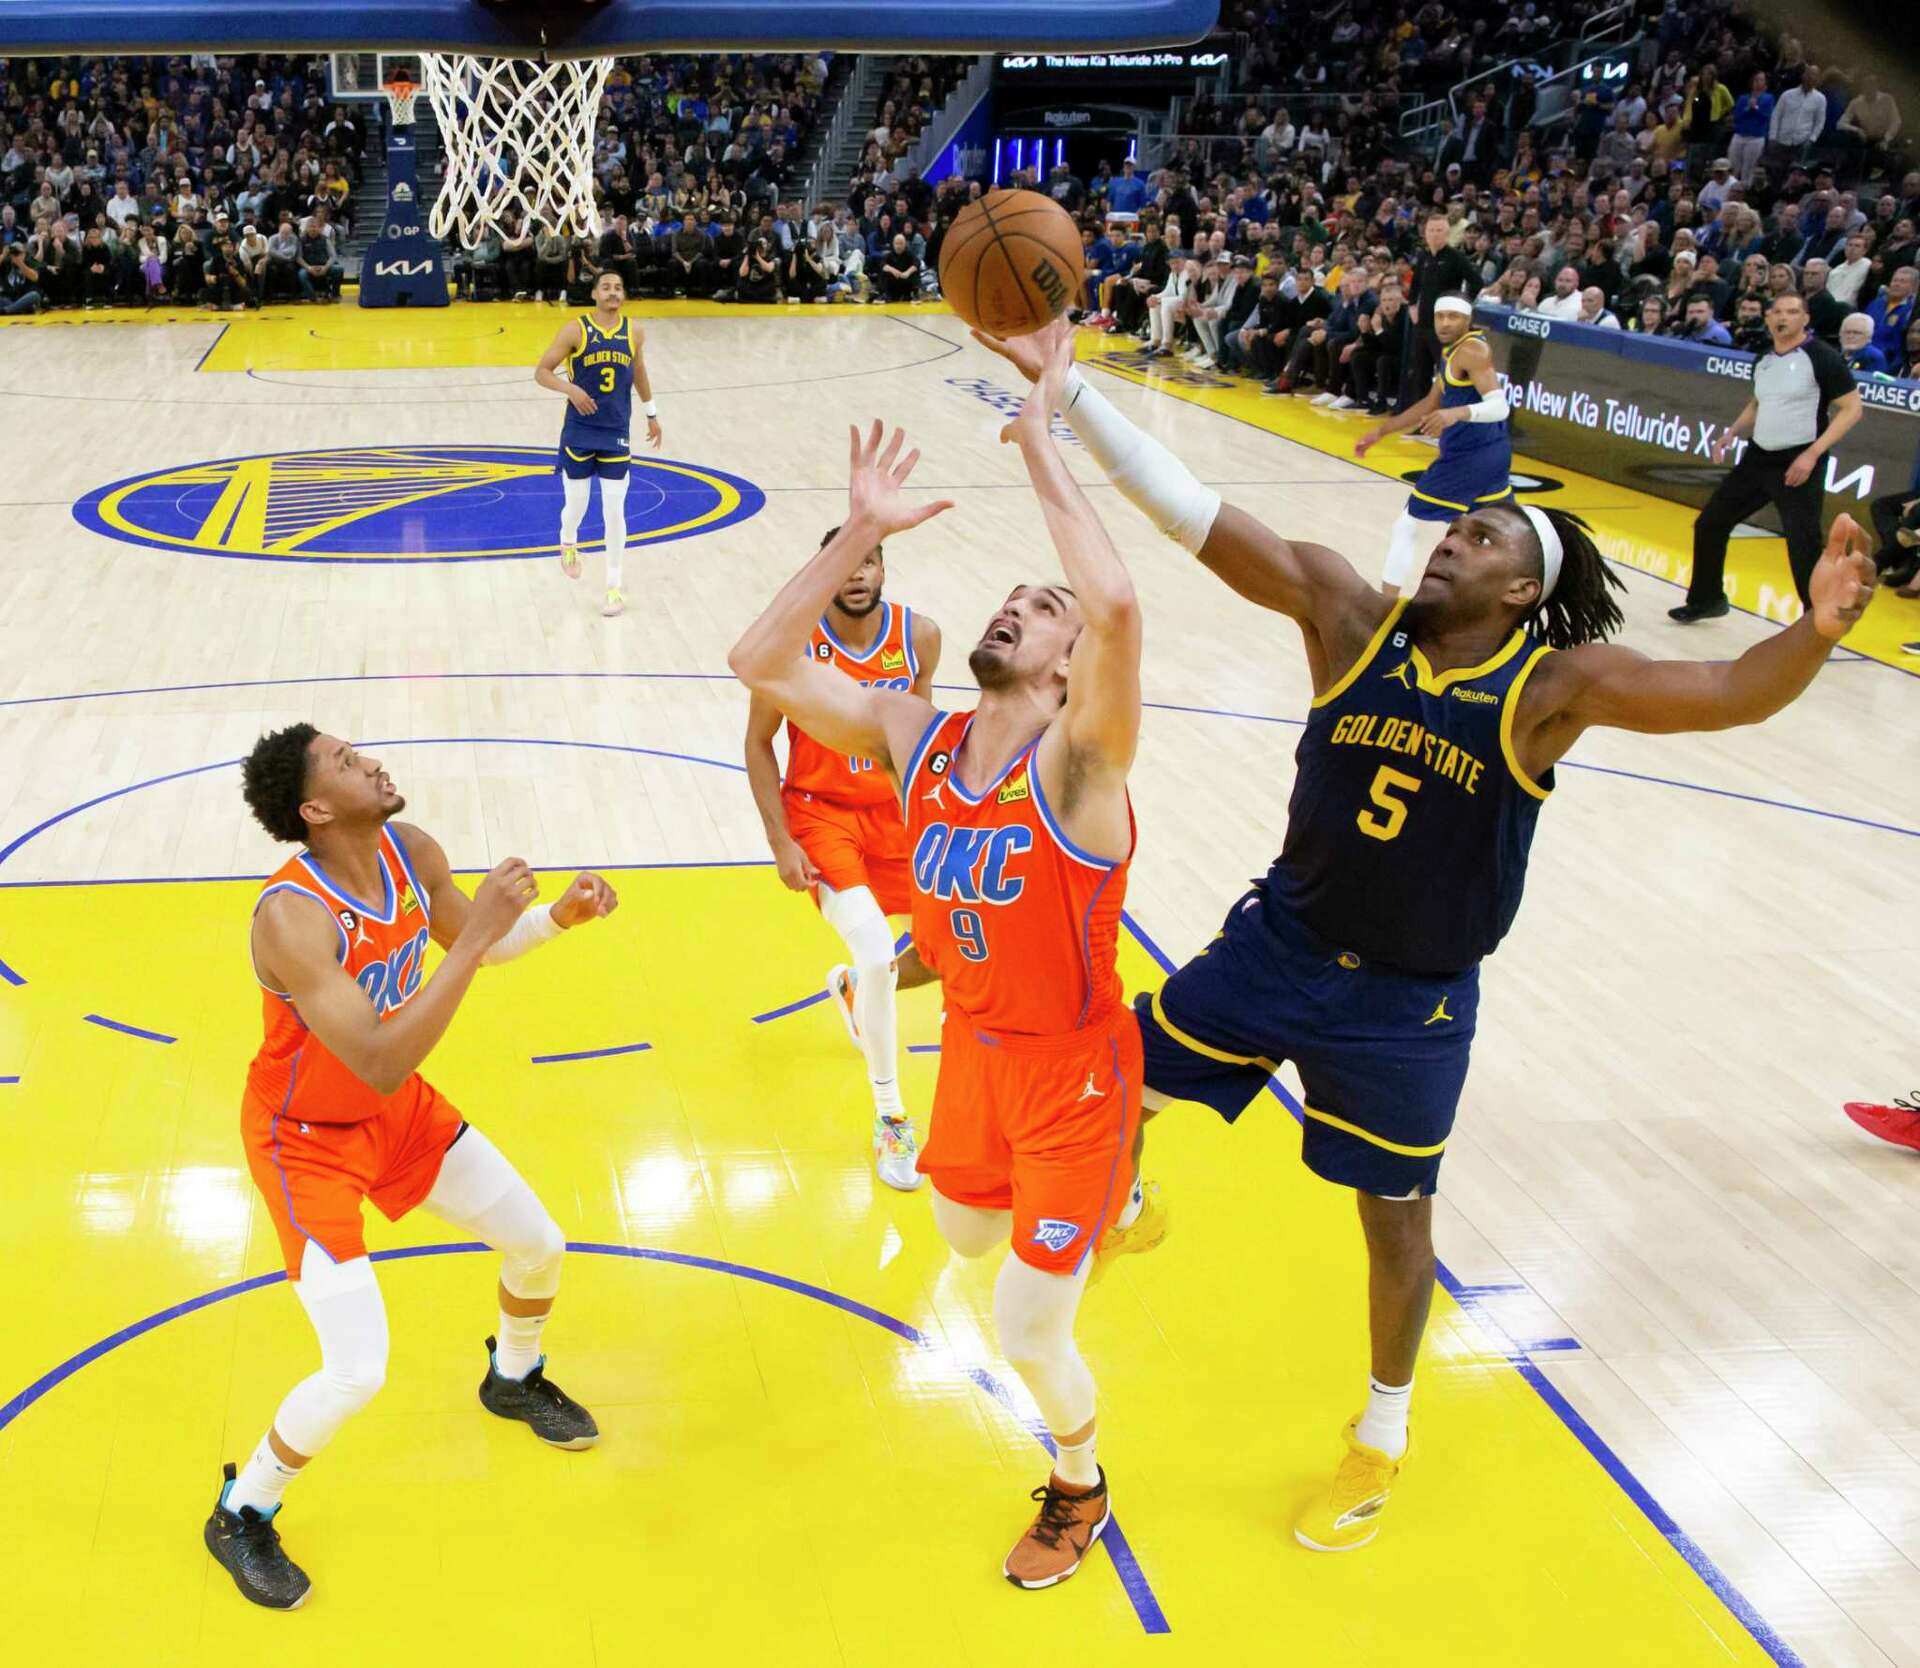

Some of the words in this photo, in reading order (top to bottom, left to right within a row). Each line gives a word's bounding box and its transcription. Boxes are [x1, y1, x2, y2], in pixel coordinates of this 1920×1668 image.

[1045, 55, 1063, 67] The
[1065, 55, 1089, 66] New
[1090, 55, 1107, 66] Kia
[1109, 54, 1152, 66] Telluride
[1153, 54, 1183, 65] X-Pro
[1508, 314, 1540, 336] CHASE
[600, 367, 615, 392] 3
[1706, 356, 1752, 380] CHASE
[1526, 380, 1567, 418] New
[1569, 390, 1598, 428] Kia
[1604, 398, 1690, 451] Telluride
[817, 643, 830, 657] 6
[1392, 632, 1408, 648] 6
[1452, 686, 1499, 705] Rakuten
[931, 753, 949, 774] 6
[1331, 714, 1426, 758] GOLDEN
[1423, 732, 1486, 796] STATE
[1356, 764, 1422, 842] 5
[912, 821, 1033, 906] OKC
[340, 911, 355, 930] 6
[951, 908, 990, 962] 9
